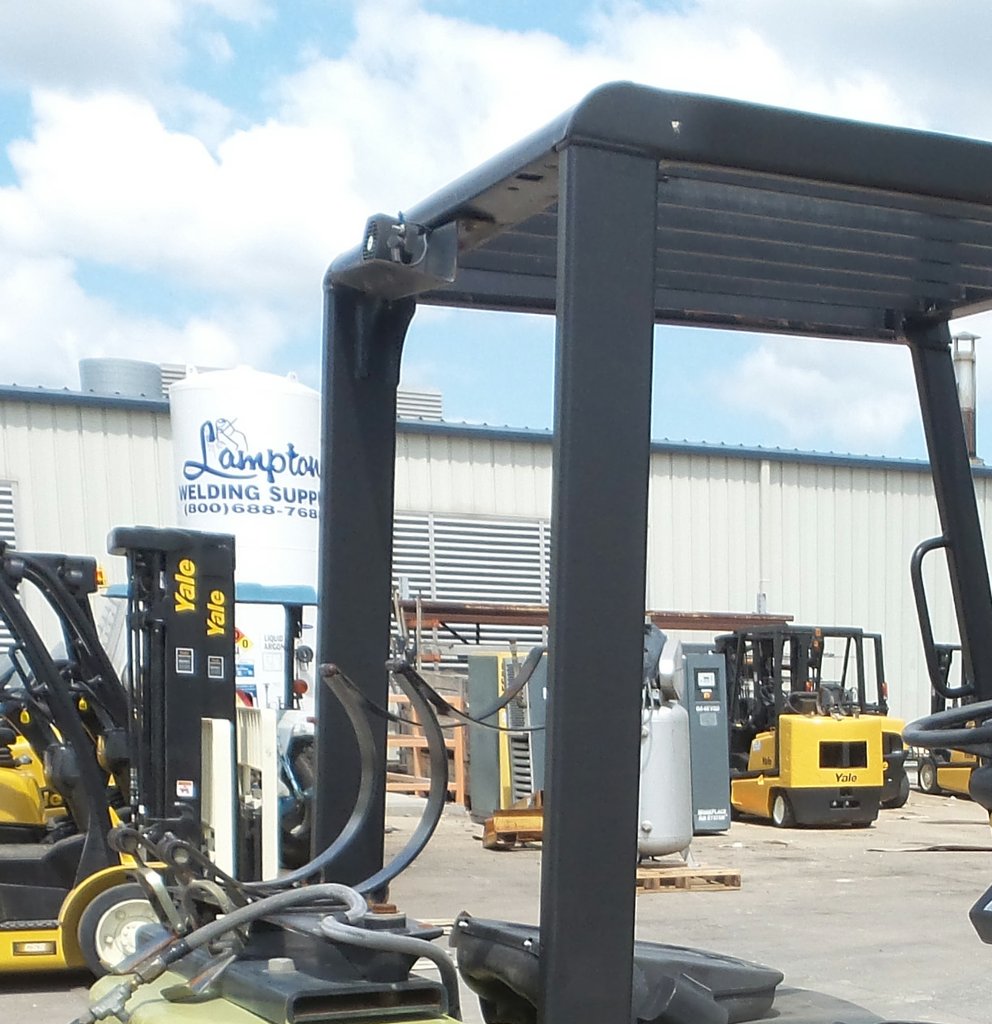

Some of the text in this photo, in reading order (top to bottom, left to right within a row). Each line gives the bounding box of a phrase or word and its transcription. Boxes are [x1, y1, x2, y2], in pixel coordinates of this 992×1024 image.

[183, 420, 320, 483] Lampton
[179, 484, 320, 505] WELDING SUPP
[184, 503, 320, 519] (800)688-768
[175, 559, 195, 612] Yale
[207, 590, 225, 636] Yale
[836, 773, 857, 783] Yale
